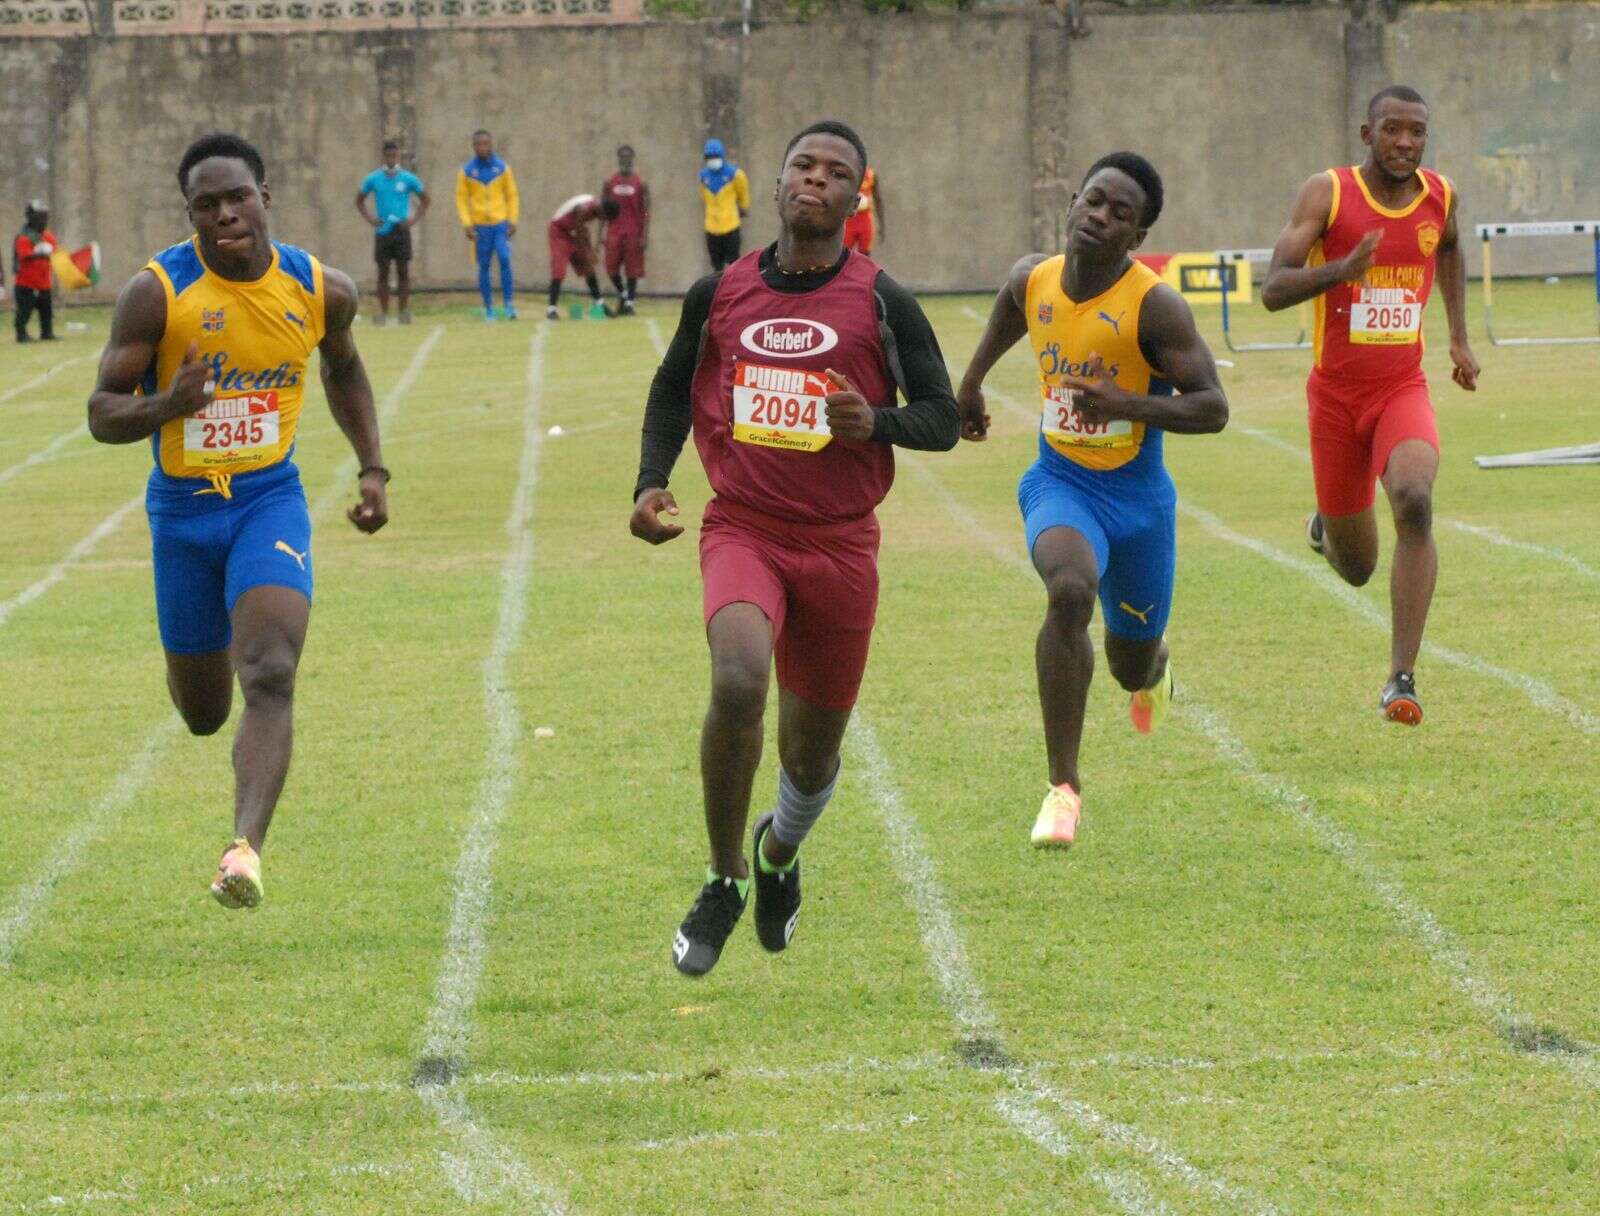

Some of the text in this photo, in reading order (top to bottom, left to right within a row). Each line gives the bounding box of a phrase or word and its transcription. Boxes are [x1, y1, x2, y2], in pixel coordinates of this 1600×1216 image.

[1366, 307, 1412, 329] 2050
[763, 325, 813, 350] Herbert
[1040, 342, 1118, 377] Stets
[744, 365, 806, 393] PUMA
[195, 396, 250, 419] UMA
[750, 393, 817, 429] 2094
[202, 418, 263, 449] 2345
[748, 433, 812, 448] GraceKennedy
